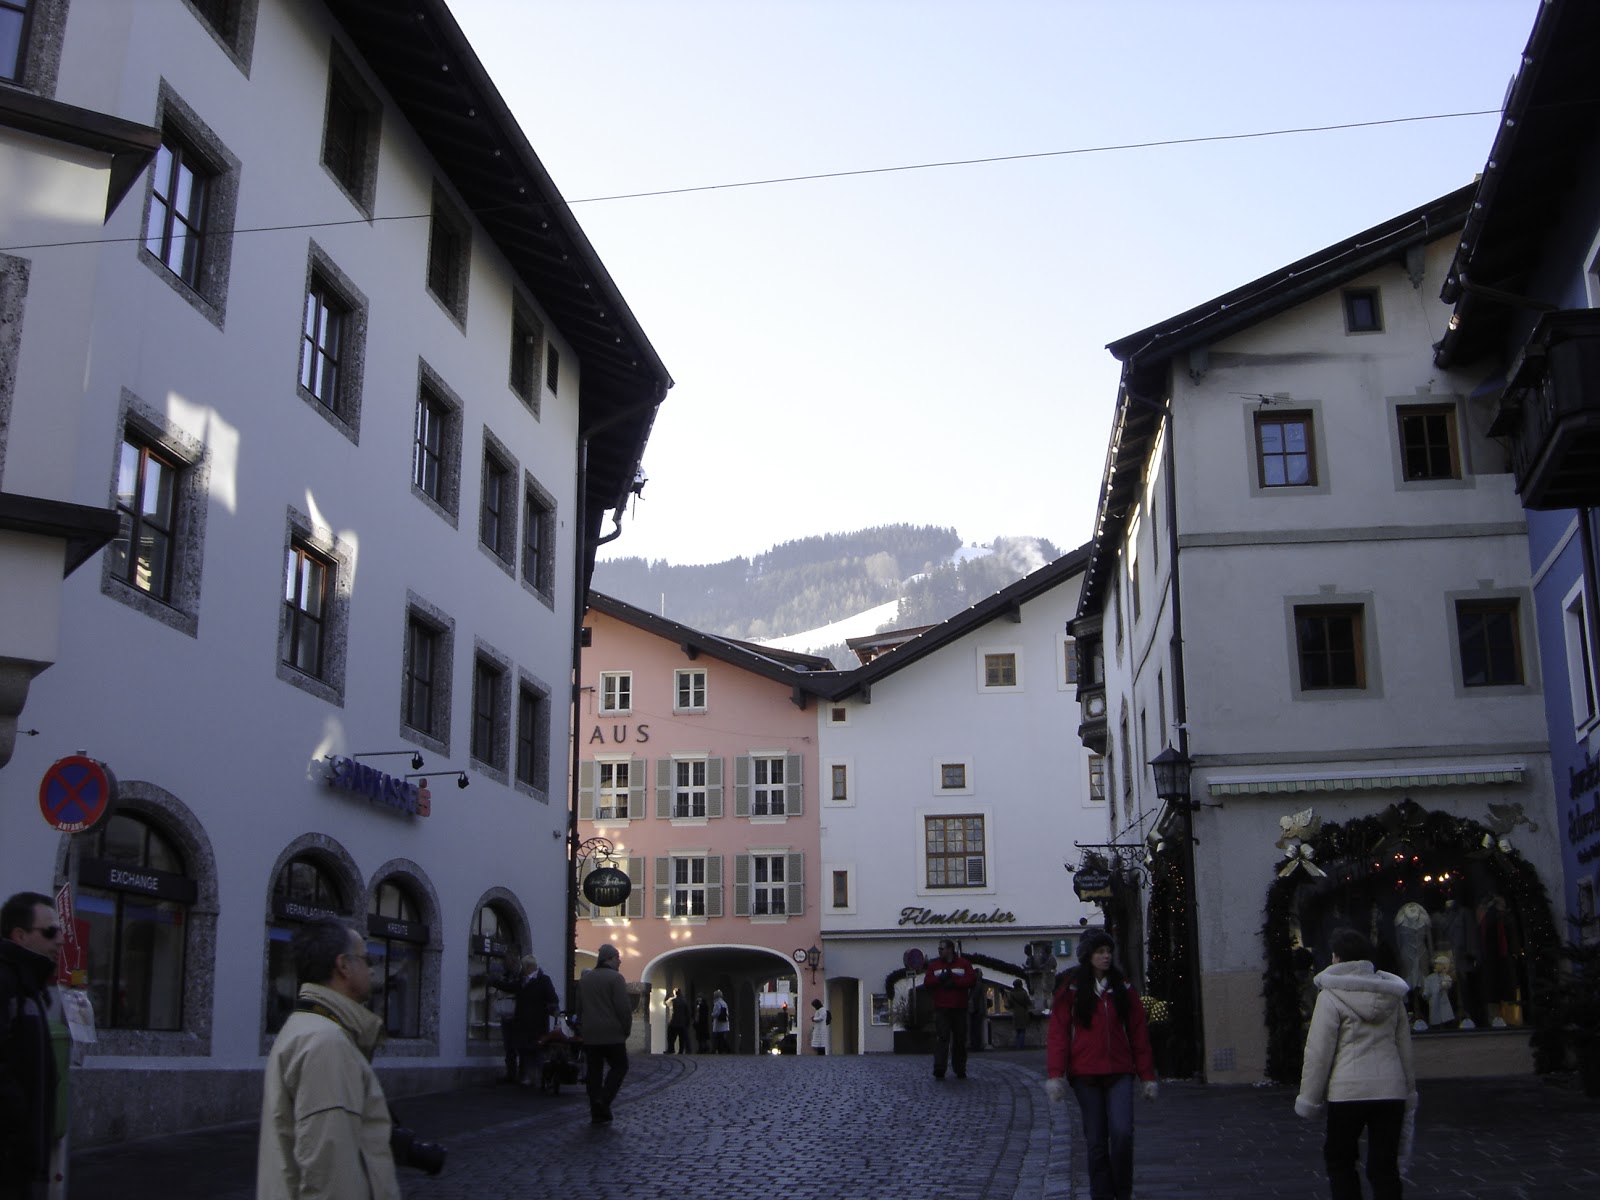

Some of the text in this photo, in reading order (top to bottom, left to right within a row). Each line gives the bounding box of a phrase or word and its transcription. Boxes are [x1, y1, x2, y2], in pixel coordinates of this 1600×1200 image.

[57, 821, 85, 831] ANFANG
[110, 868, 160, 891] EXCHANGE
[898, 906, 1016, 926] Filmtheater
[387, 922, 409, 936] KREDITE
